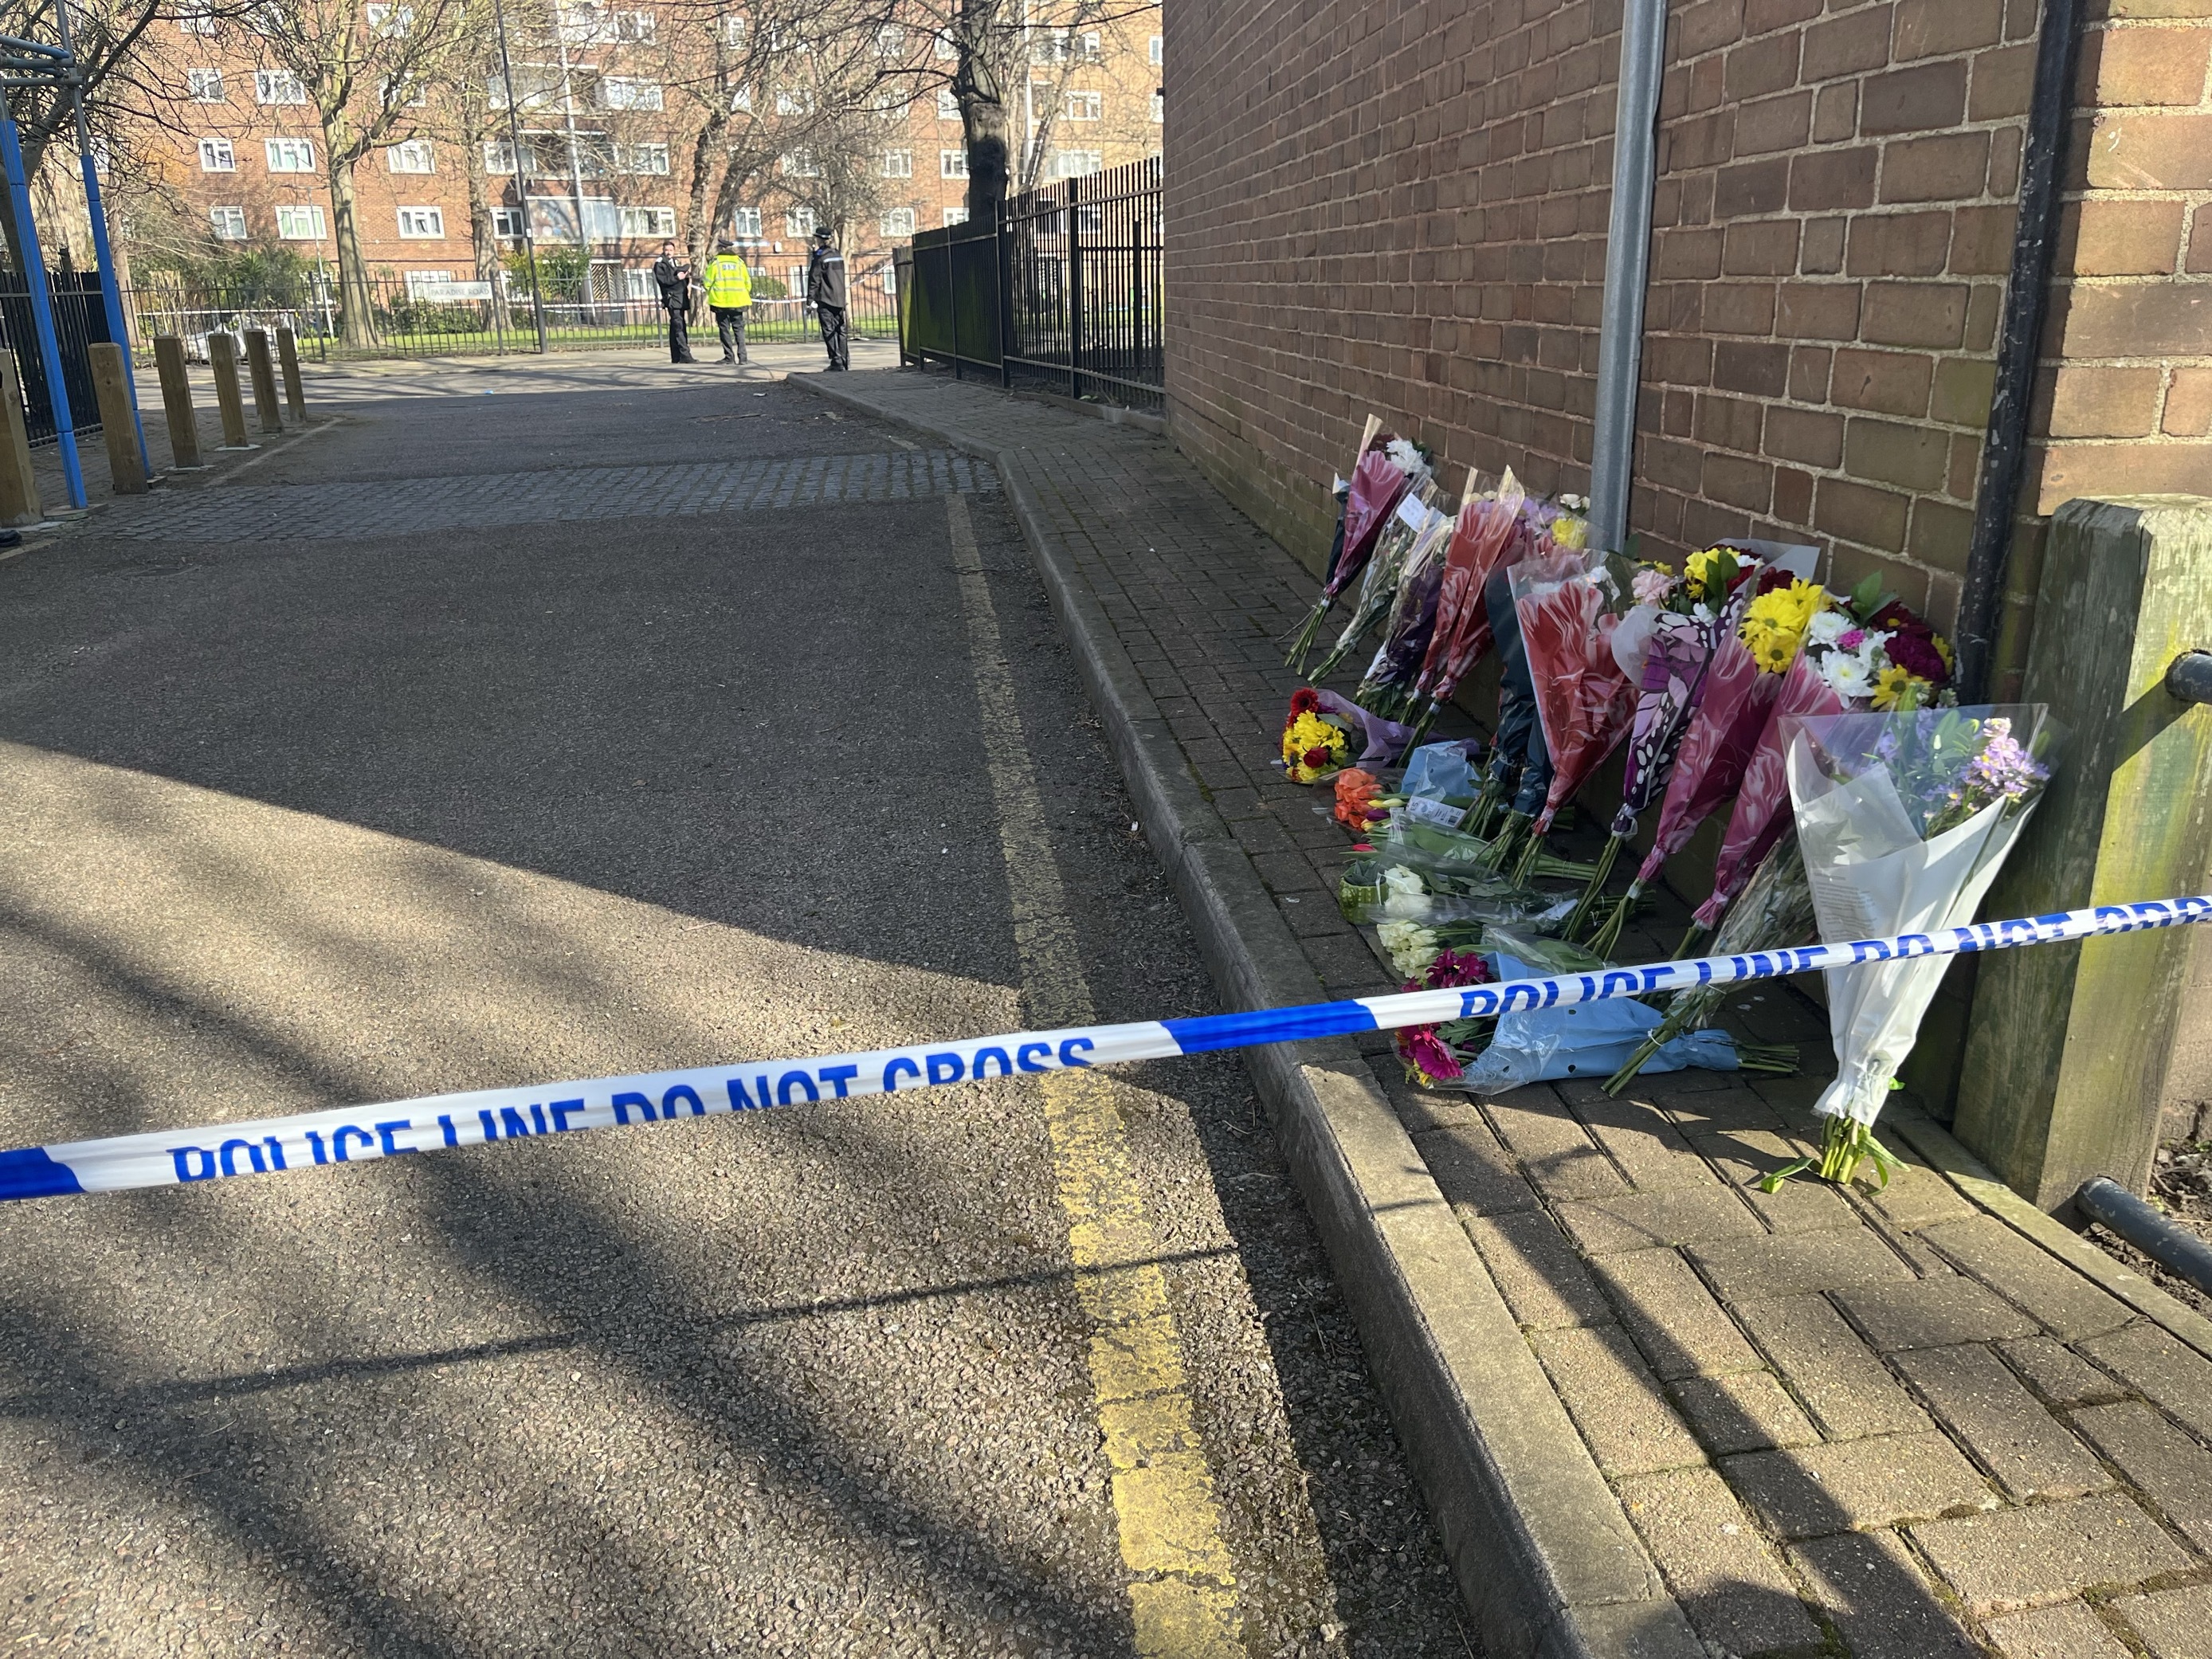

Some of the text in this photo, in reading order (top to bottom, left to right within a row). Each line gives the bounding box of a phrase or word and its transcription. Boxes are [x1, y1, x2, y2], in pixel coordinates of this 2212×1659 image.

[1459, 966, 1676, 1018] POLICE
[166, 1119, 418, 1182] POLICE
[611, 1084, 706, 1125] DO
[726, 1064, 859, 1112] NOT
[882, 1037, 1095, 1092] CROSS
